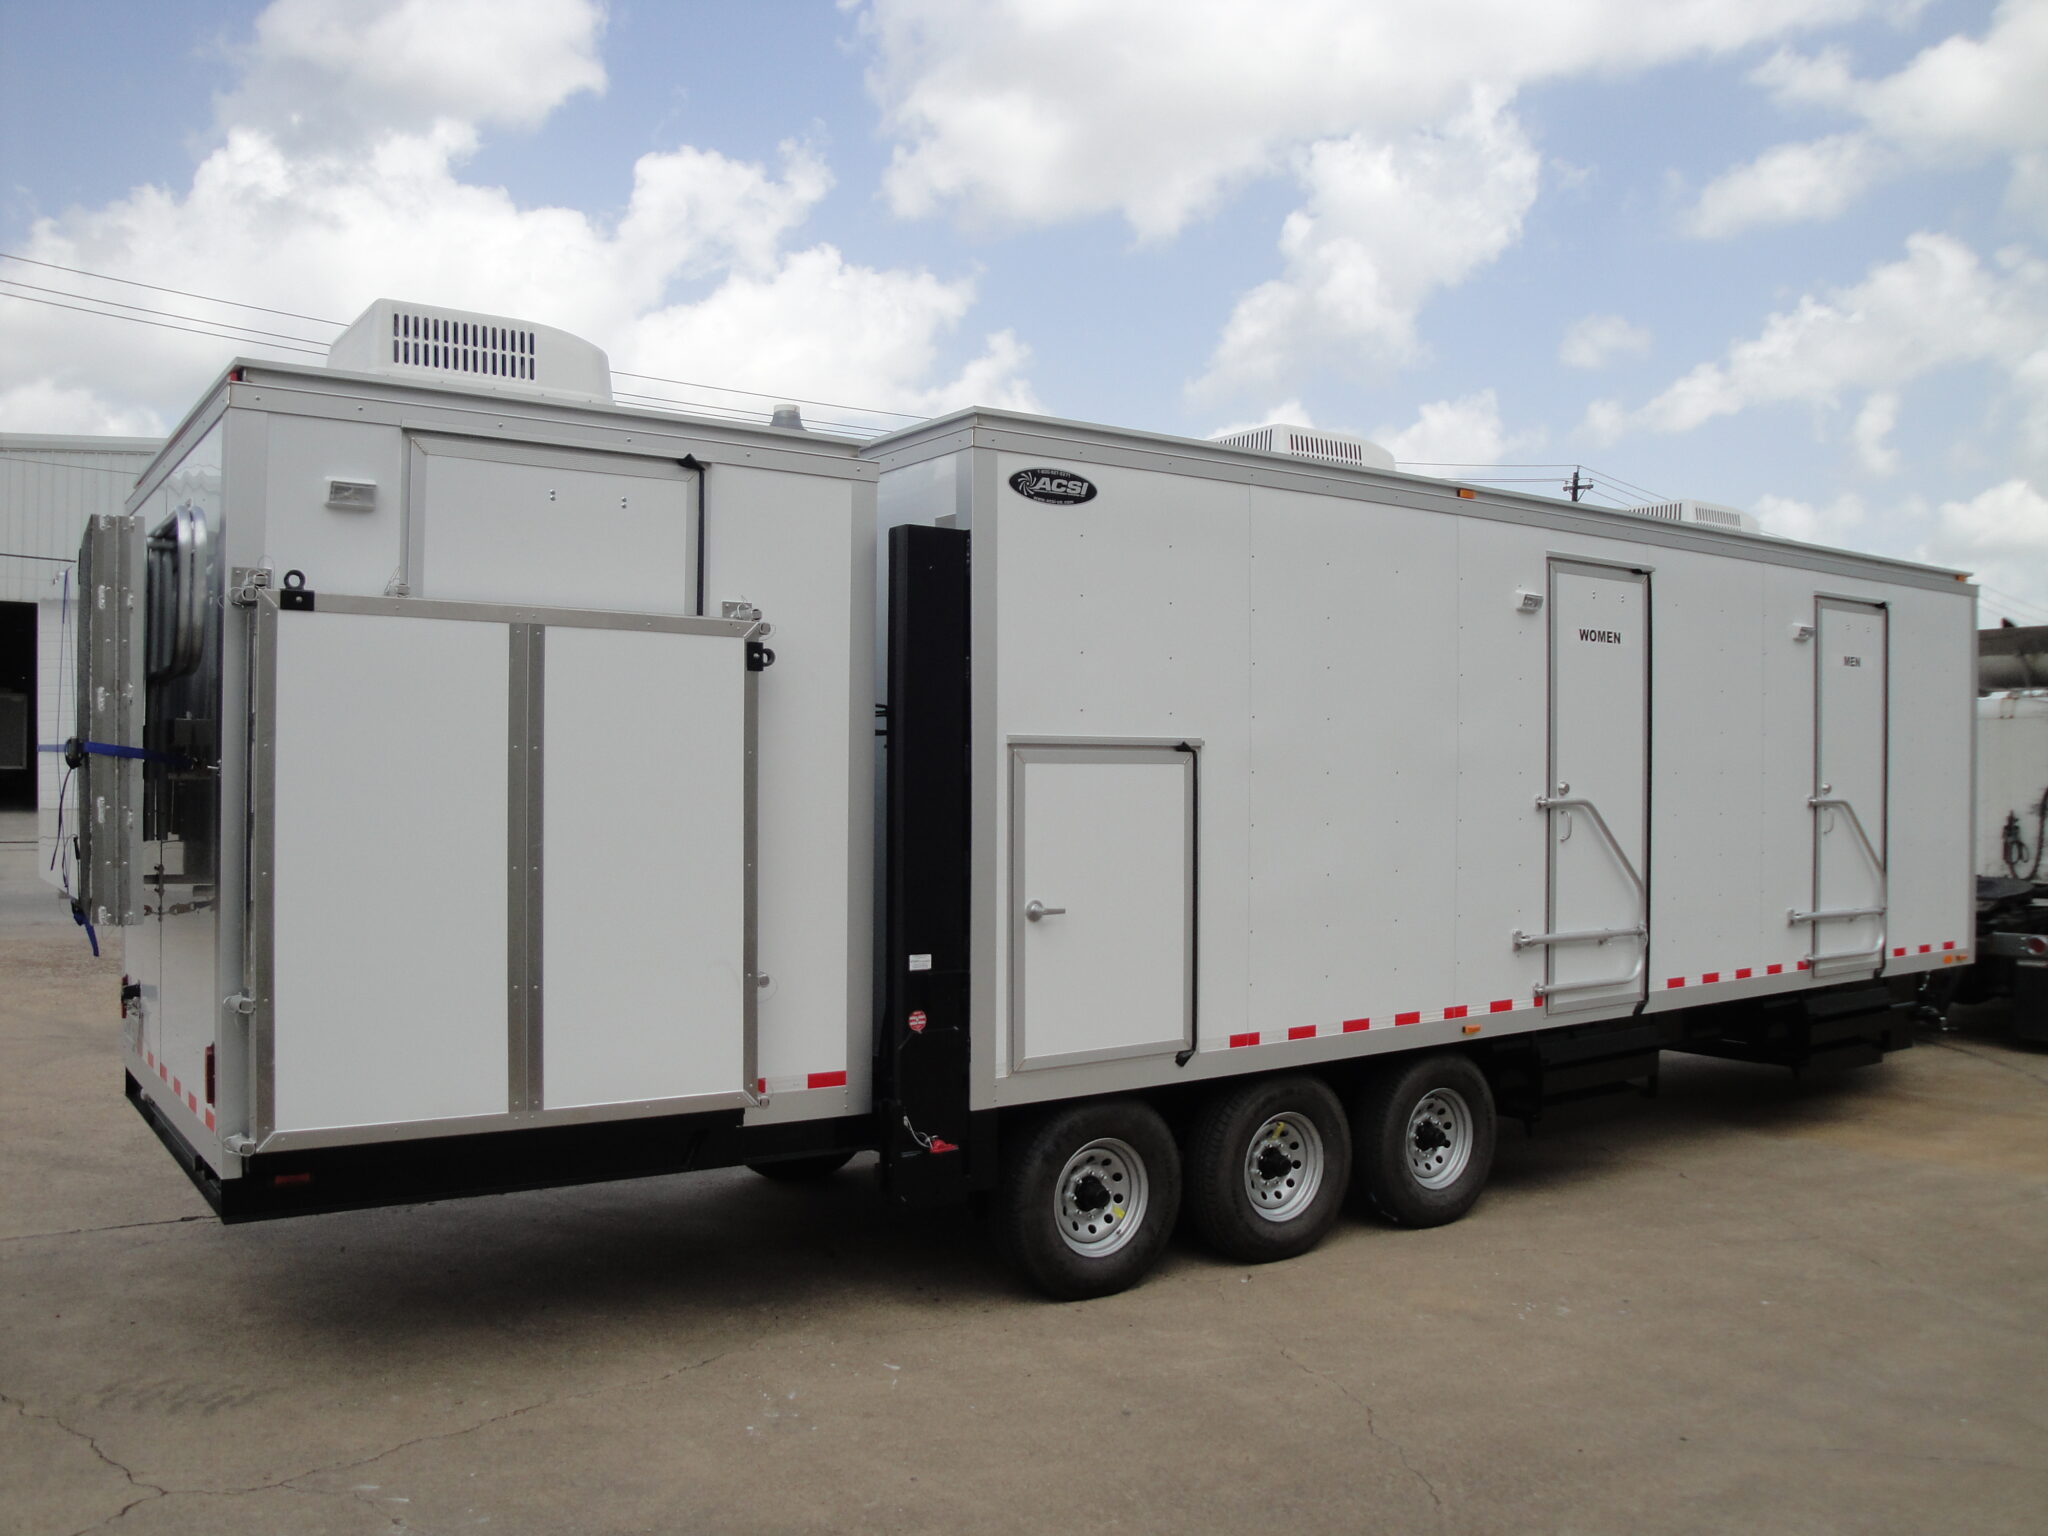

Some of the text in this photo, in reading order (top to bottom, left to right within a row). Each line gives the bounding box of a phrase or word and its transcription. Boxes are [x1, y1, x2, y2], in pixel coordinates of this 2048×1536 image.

[1033, 477, 1089, 496] ACSI
[1579, 628, 1621, 645] WOMEN
[1844, 656, 1861, 667] MEN
